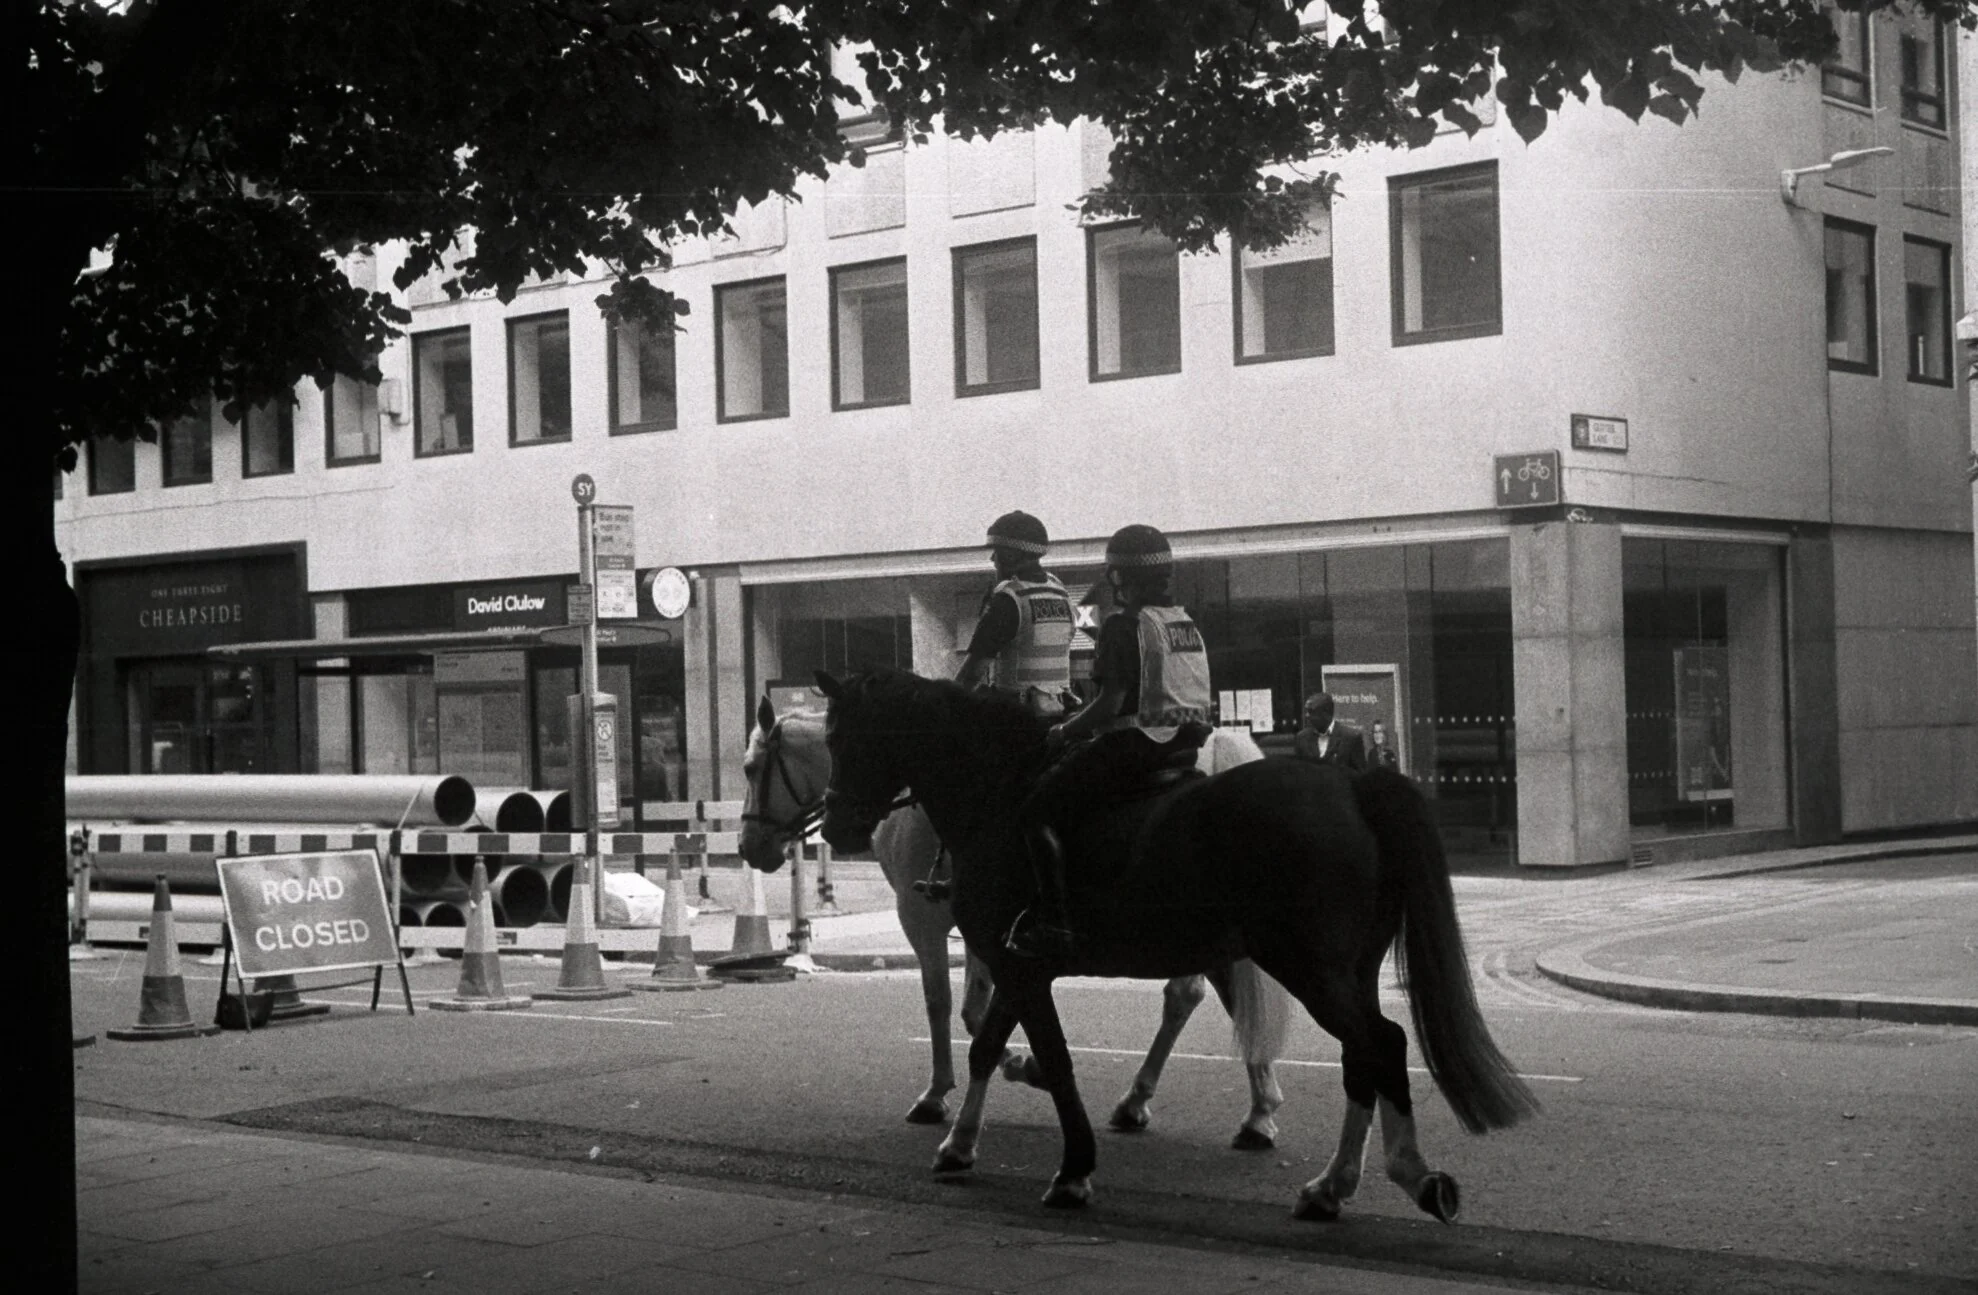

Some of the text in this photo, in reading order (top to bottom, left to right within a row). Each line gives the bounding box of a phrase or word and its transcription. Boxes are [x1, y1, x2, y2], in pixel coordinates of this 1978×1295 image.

[577, 482, 593, 497] SY
[201, 583, 228, 595] EIGHT
[468, 594, 545, 614] David Clulow
[140, 603, 242, 628] CHEAPSIDE
[1332, 693, 1350, 703] Here
[1351, 694, 1359, 703] to
[260, 875, 345, 905] ROAD
[255, 918, 370, 951] CLOSED
